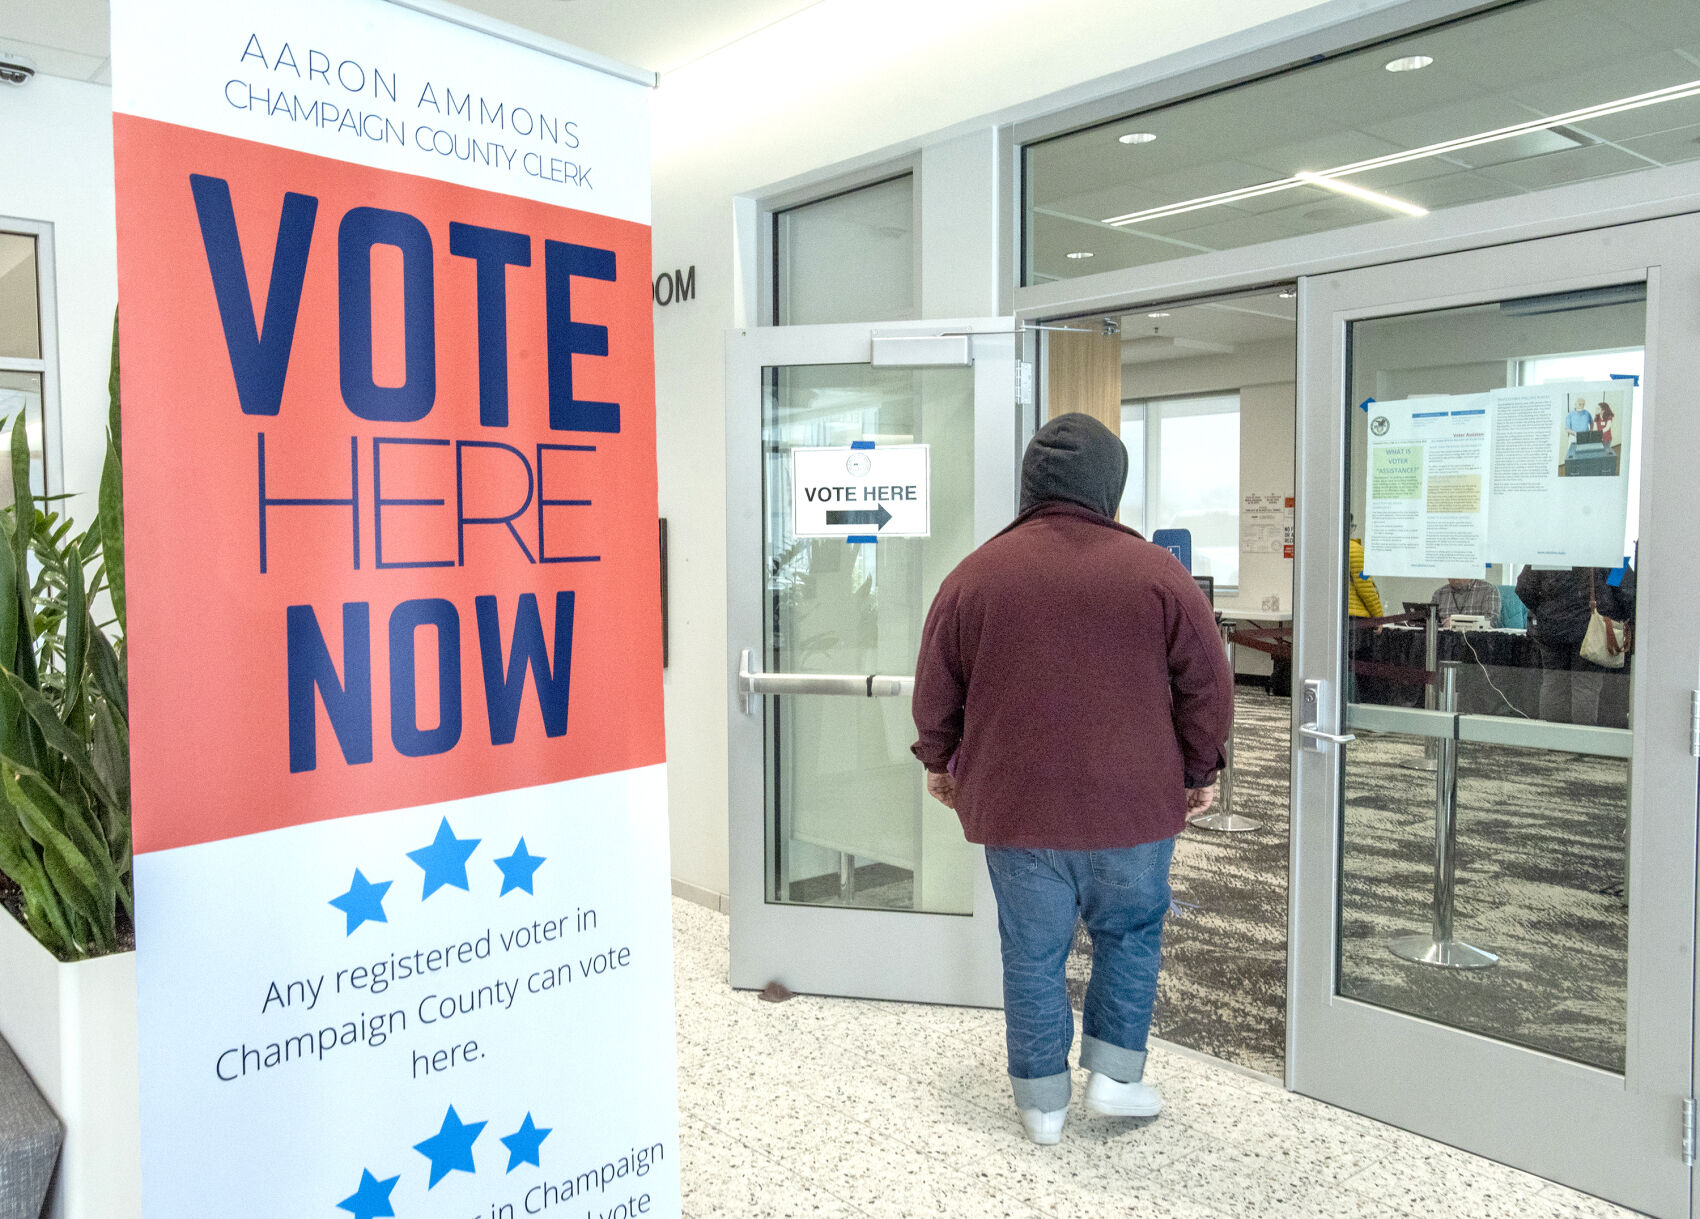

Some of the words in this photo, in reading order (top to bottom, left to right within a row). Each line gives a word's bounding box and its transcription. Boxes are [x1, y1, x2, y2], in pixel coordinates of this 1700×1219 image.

[225, 80, 404, 146] CHAMPAIGN
[415, 126, 517, 170] COUNTY
[524, 153, 592, 189] CLERK
[241, 33, 396, 102] AARON
[418, 82, 579, 148] AMMONS
[189, 173, 621, 434] VOTE
[653, 266, 695, 306] OM
[258, 432, 601, 574] HERE
[805, 487, 857, 502] VOTE
[864, 486, 917, 501] HERE
[286, 590, 575, 774] NOW
[216, 1010, 405, 1082] Champaign
[419, 978, 518, 1024] County
[528, 964, 571, 993] can
[580, 947, 630, 978] vote
[262, 975, 324, 1014] Any
[337, 928, 490, 994] registered
[500, 916, 568, 952] voter
[577, 907, 596, 932] in
[413, 1041, 485, 1079] here.
[525, 1143, 663, 1214] Champaign
